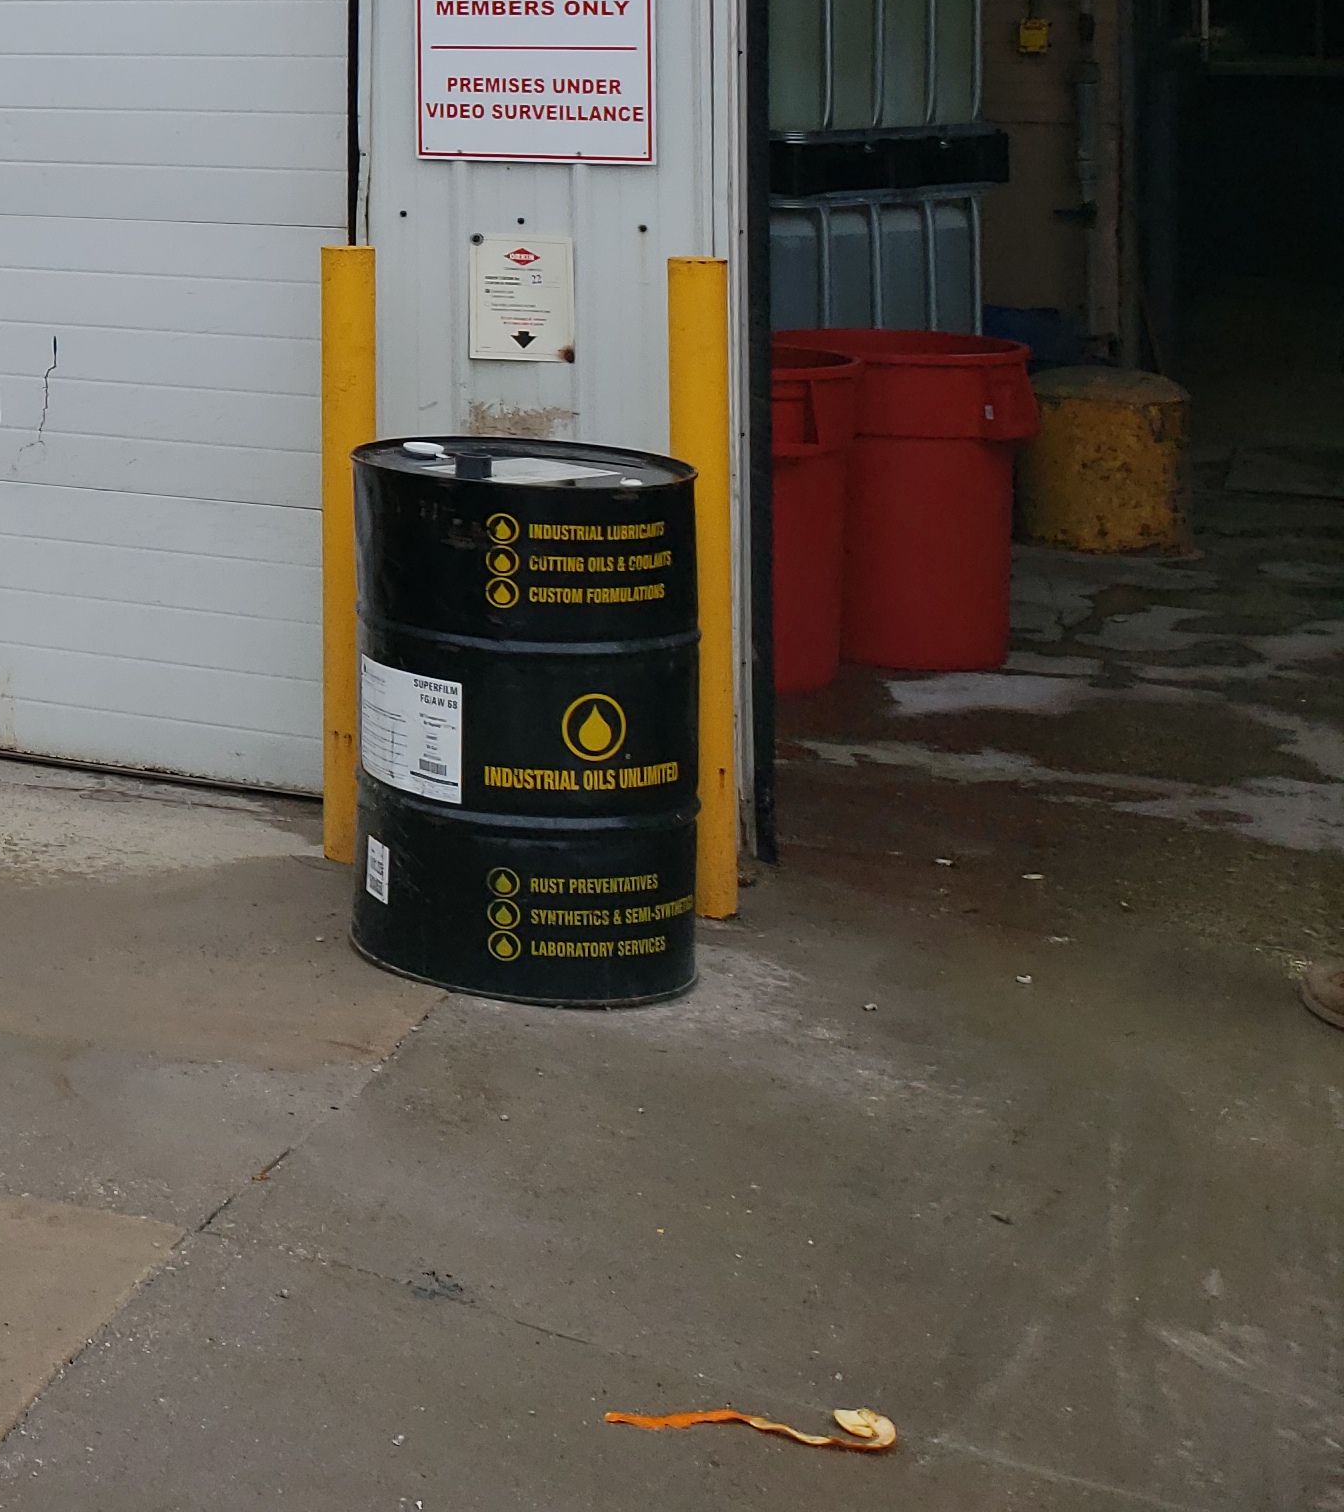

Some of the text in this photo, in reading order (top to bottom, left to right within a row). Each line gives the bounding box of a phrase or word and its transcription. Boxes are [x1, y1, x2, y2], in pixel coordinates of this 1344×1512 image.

[435, 0, 630, 16] MEMBERS ONLY
[447, 77, 622, 95] PREMISES UNDER
[425, 102, 644, 122] VIDEO SURVEILLANCE
[529, 521, 665, 541] INDUSTRIAL LUBRICANTS
[529, 550, 672, 572] CUTTING OILS & COOLANTS
[529, 583, 665, 604] CUSTOM FORMULATIONS
[413, 678, 458, 696] SUPERFILM
[447, 697, 458, 709] 68
[484, 766, 580, 791] INDUSTRIAL
[582, 769, 616, 791] OILS
[619, 761, 678, 788] UNLIMITED
[530, 873, 659, 894] RUST PREVENTATIVES
[530, 909, 610, 926] SYNTHETICS
[613, 909, 622, 925] &
[531, 936, 666, 958] LABORATORY SERVICES
